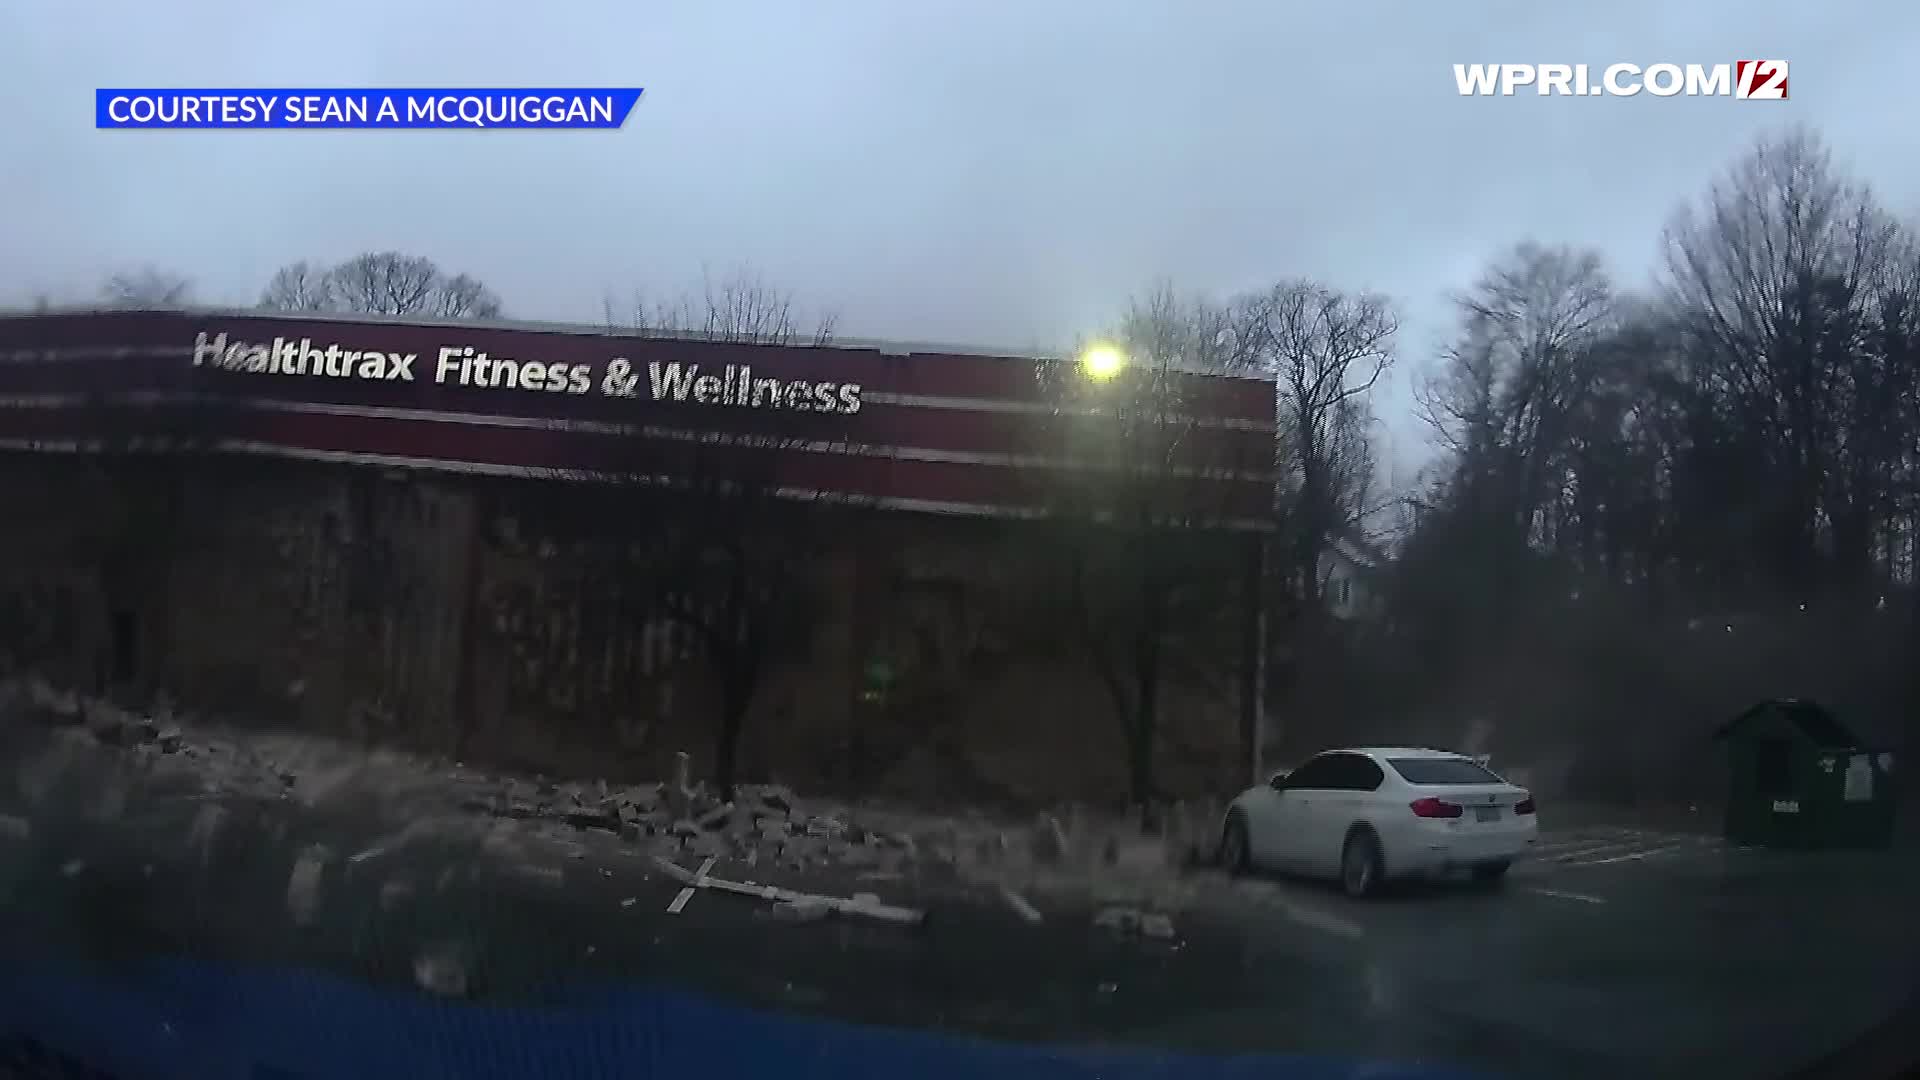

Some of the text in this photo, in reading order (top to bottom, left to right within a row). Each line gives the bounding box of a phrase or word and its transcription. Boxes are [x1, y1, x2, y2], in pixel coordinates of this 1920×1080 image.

[193, 331, 862, 416] Healthtrax Fitness & Wellness
